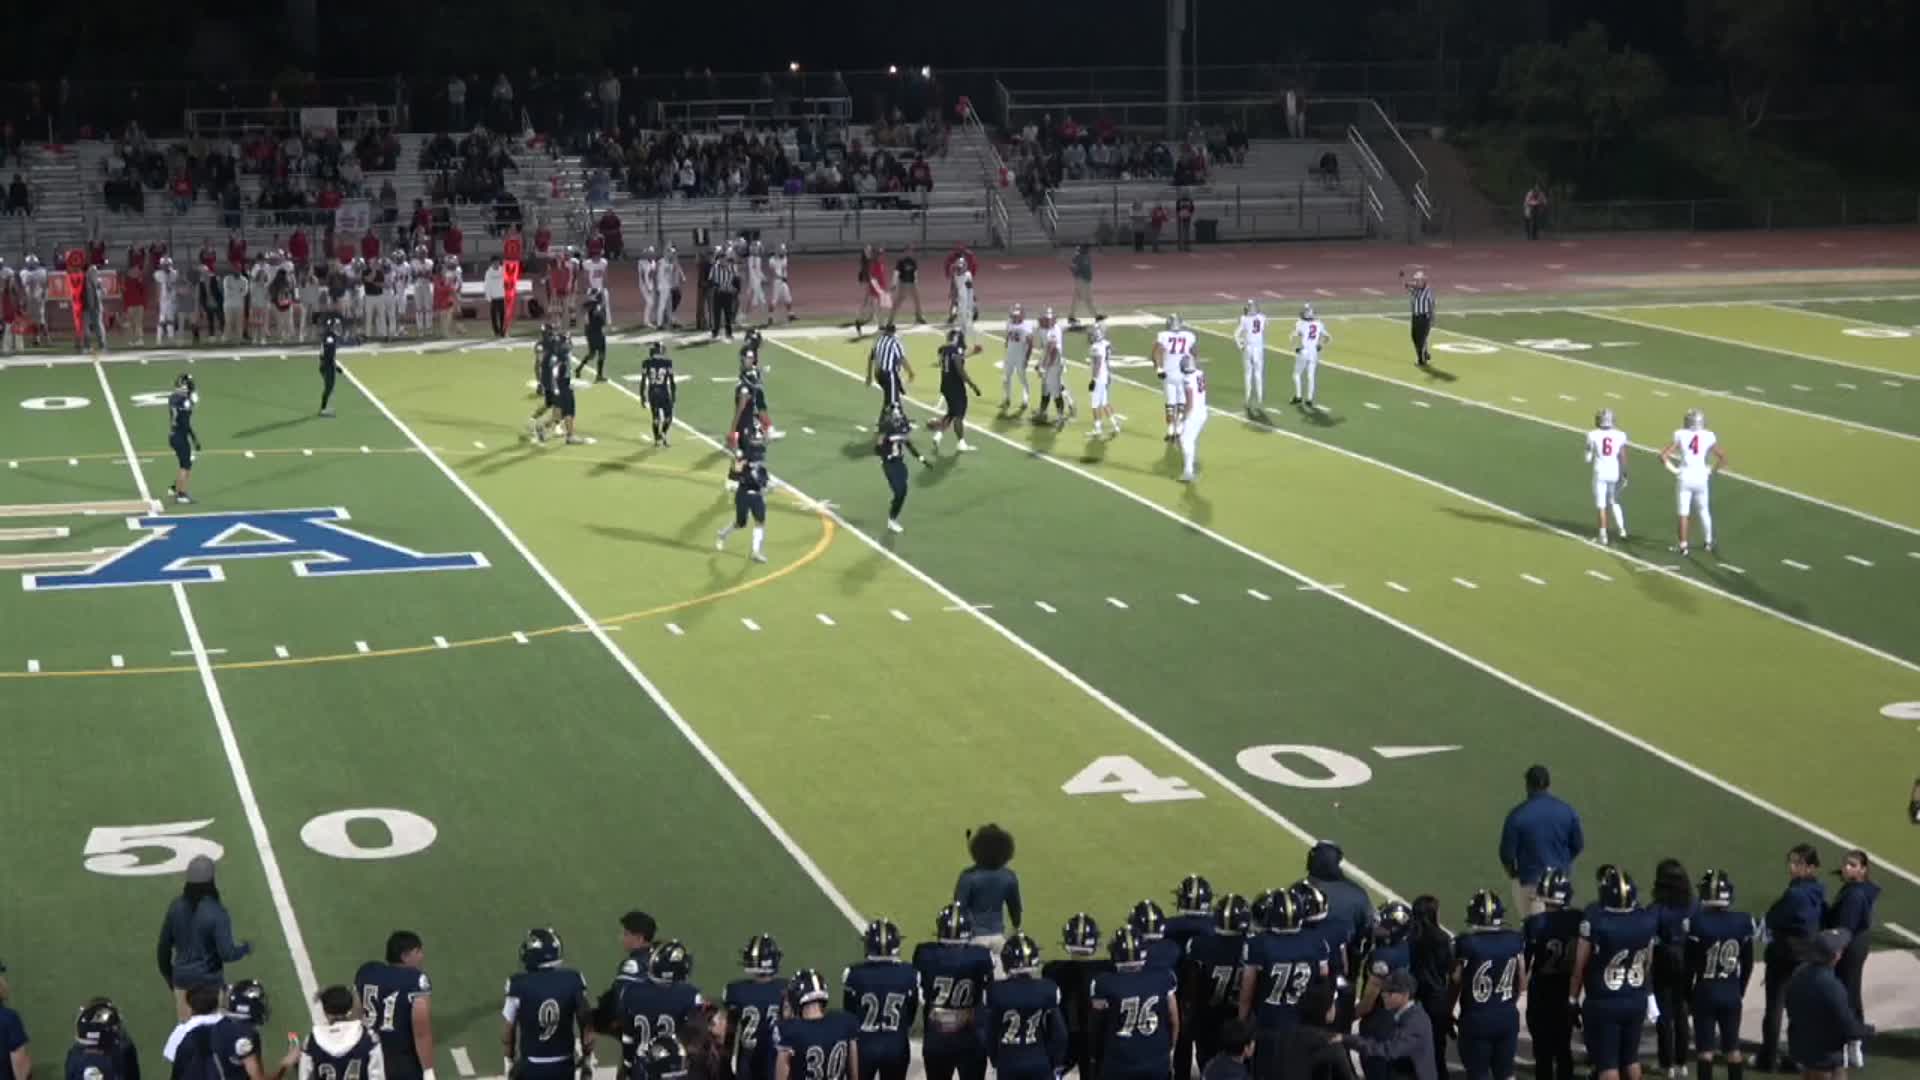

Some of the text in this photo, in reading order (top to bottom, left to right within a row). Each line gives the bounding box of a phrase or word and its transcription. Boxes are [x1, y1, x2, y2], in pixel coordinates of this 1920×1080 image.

[1168, 337, 1187, 354] 77
[1308, 324, 1317, 339] 2
[1602, 437, 1612, 456] 6
[1688, 435, 1699, 454] 4
[1704, 939, 1739, 978] 19
[1264, 962, 1311, 1005] 73
[1472, 957, 1517, 1002] 64
[363, 984, 399, 1031] 51
[538, 999, 560, 1040] 9
[861, 993, 904, 1032] 25
[1002, 1009, 1042, 1044] 21
[1117, 996, 1159, 1036] 76
[805, 1041, 848, 1080] 30
